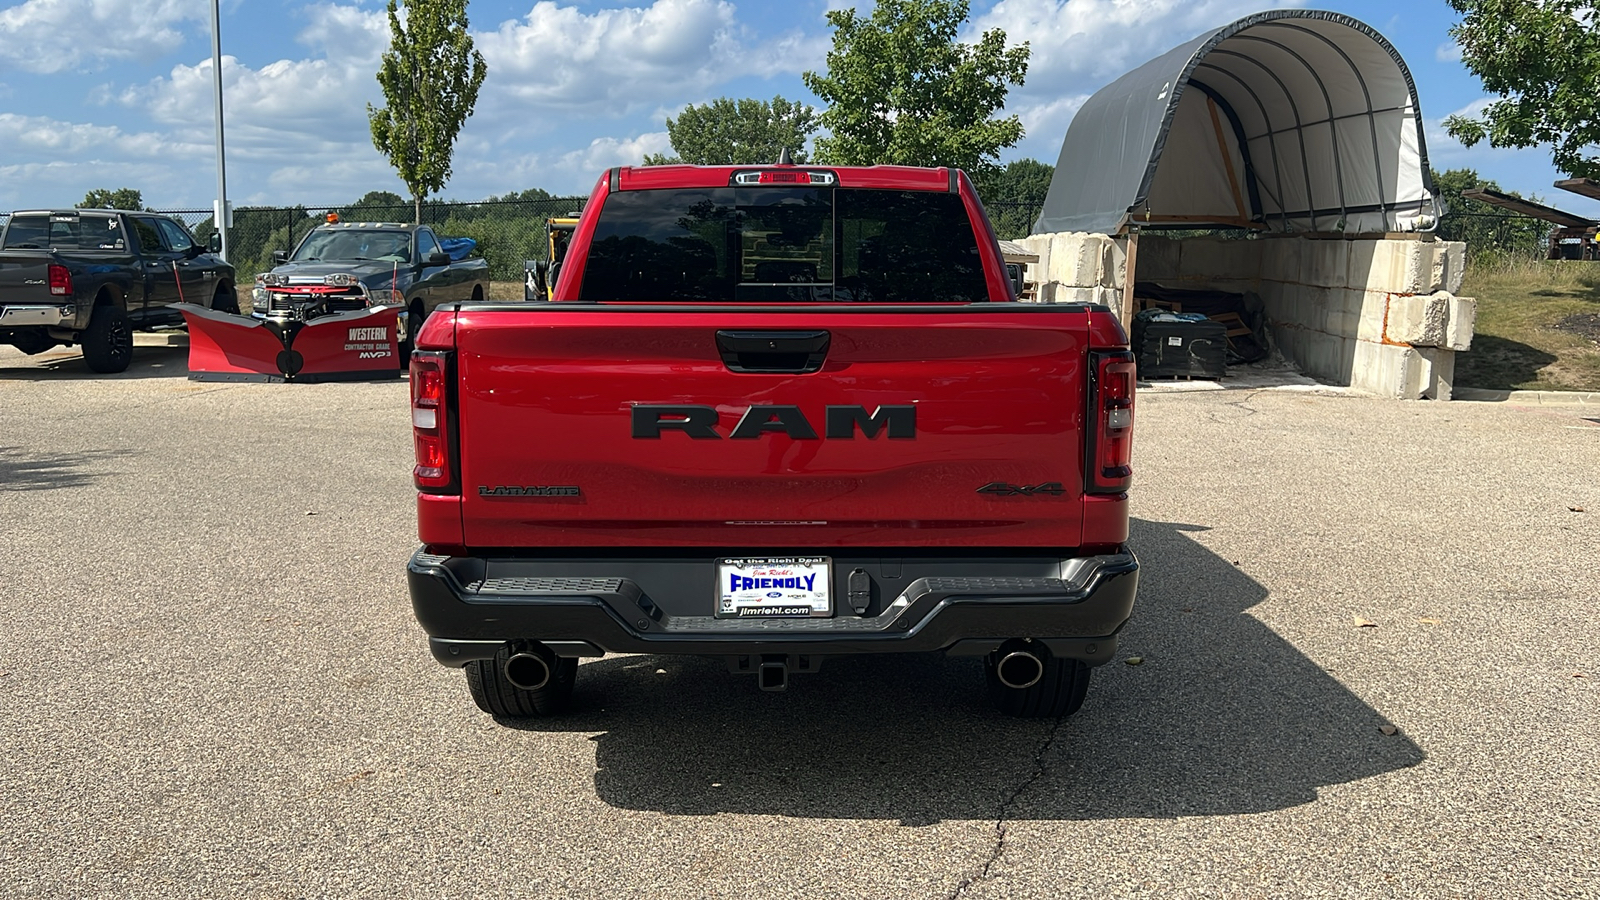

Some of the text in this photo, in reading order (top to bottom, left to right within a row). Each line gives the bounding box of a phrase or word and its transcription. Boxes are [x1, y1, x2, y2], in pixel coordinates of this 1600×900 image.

[348, 327, 387, 341] WESTERN
[344, 343, 374, 351] CONTRACTOR
[631, 404, 917, 440] RAM
[478, 485, 580, 497] LARAMIE
[752, 569, 767, 577] Jim
[730, 572, 816, 592] FRIENDLY
[739, 606, 809, 617] jimriehl.com
